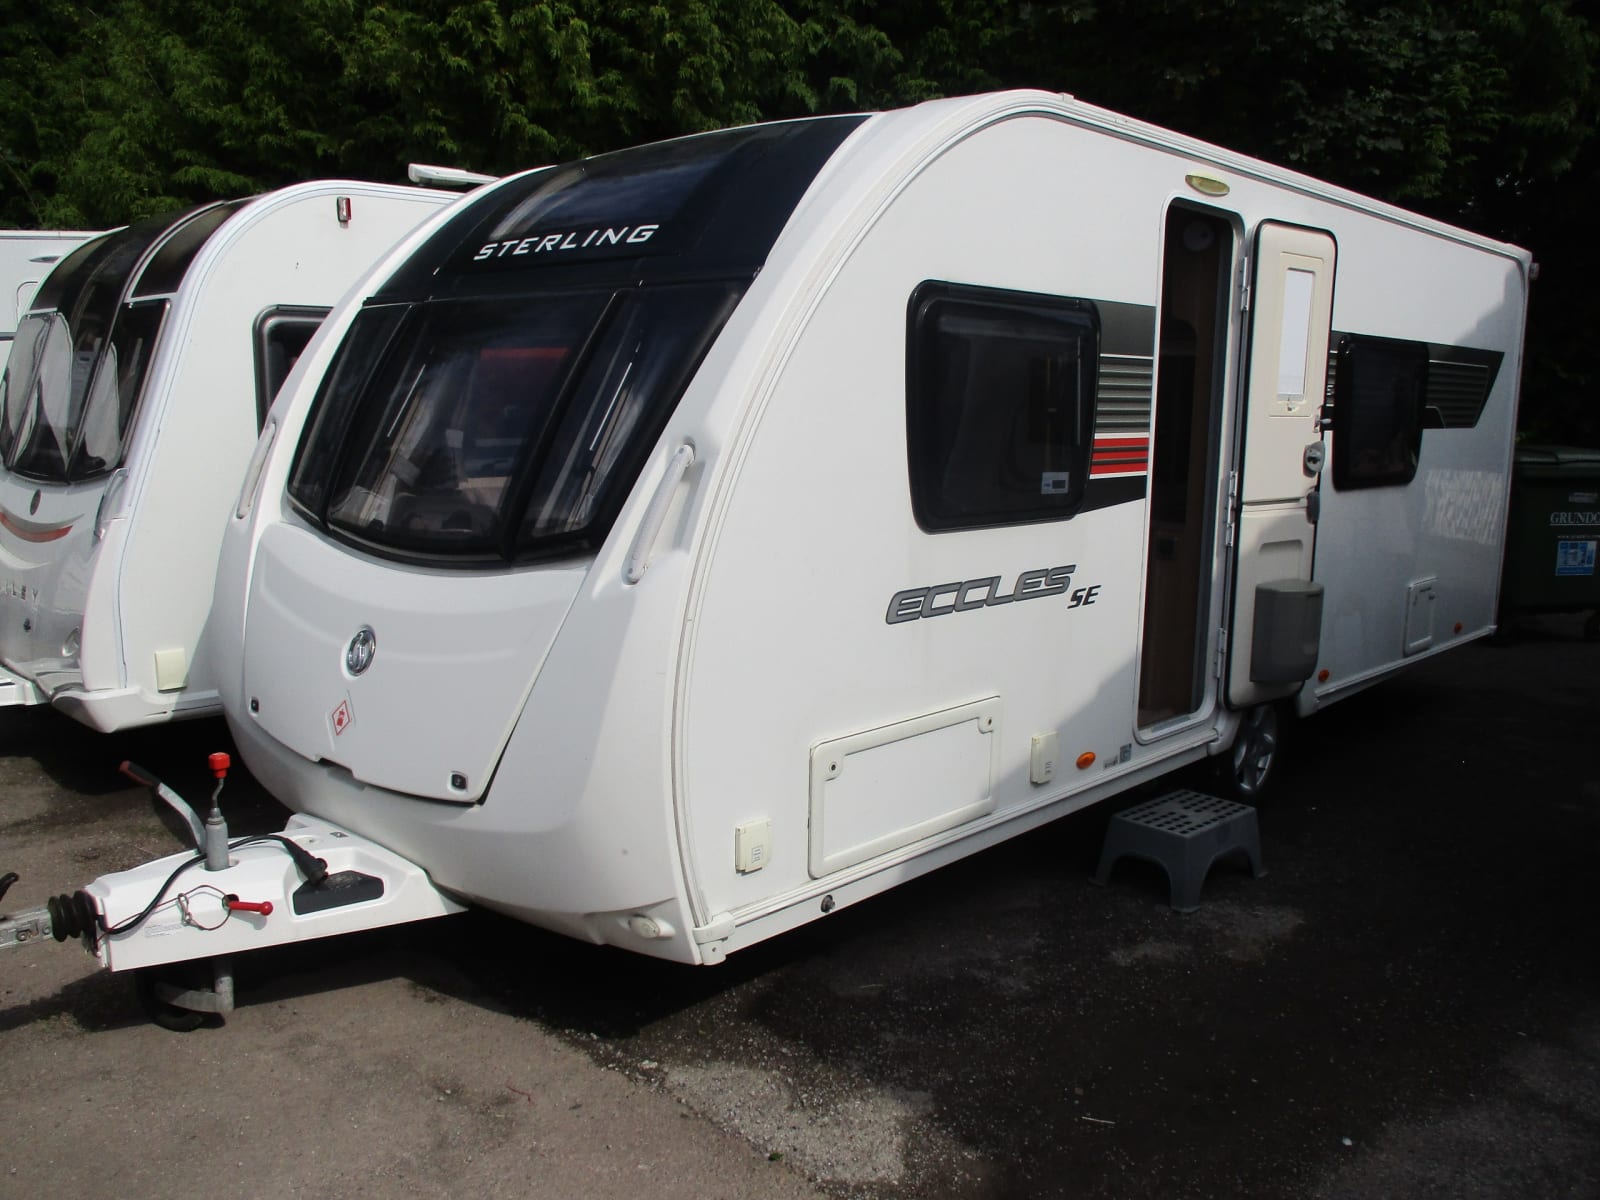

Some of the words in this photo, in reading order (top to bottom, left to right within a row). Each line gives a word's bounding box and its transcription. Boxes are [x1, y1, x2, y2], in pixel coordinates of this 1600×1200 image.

[473, 224, 659, 260] STERLING
[0, 581, 40, 602] ILEY
[885, 564, 1076, 625] ECCLES
[1067, 585, 1102, 609] SE
